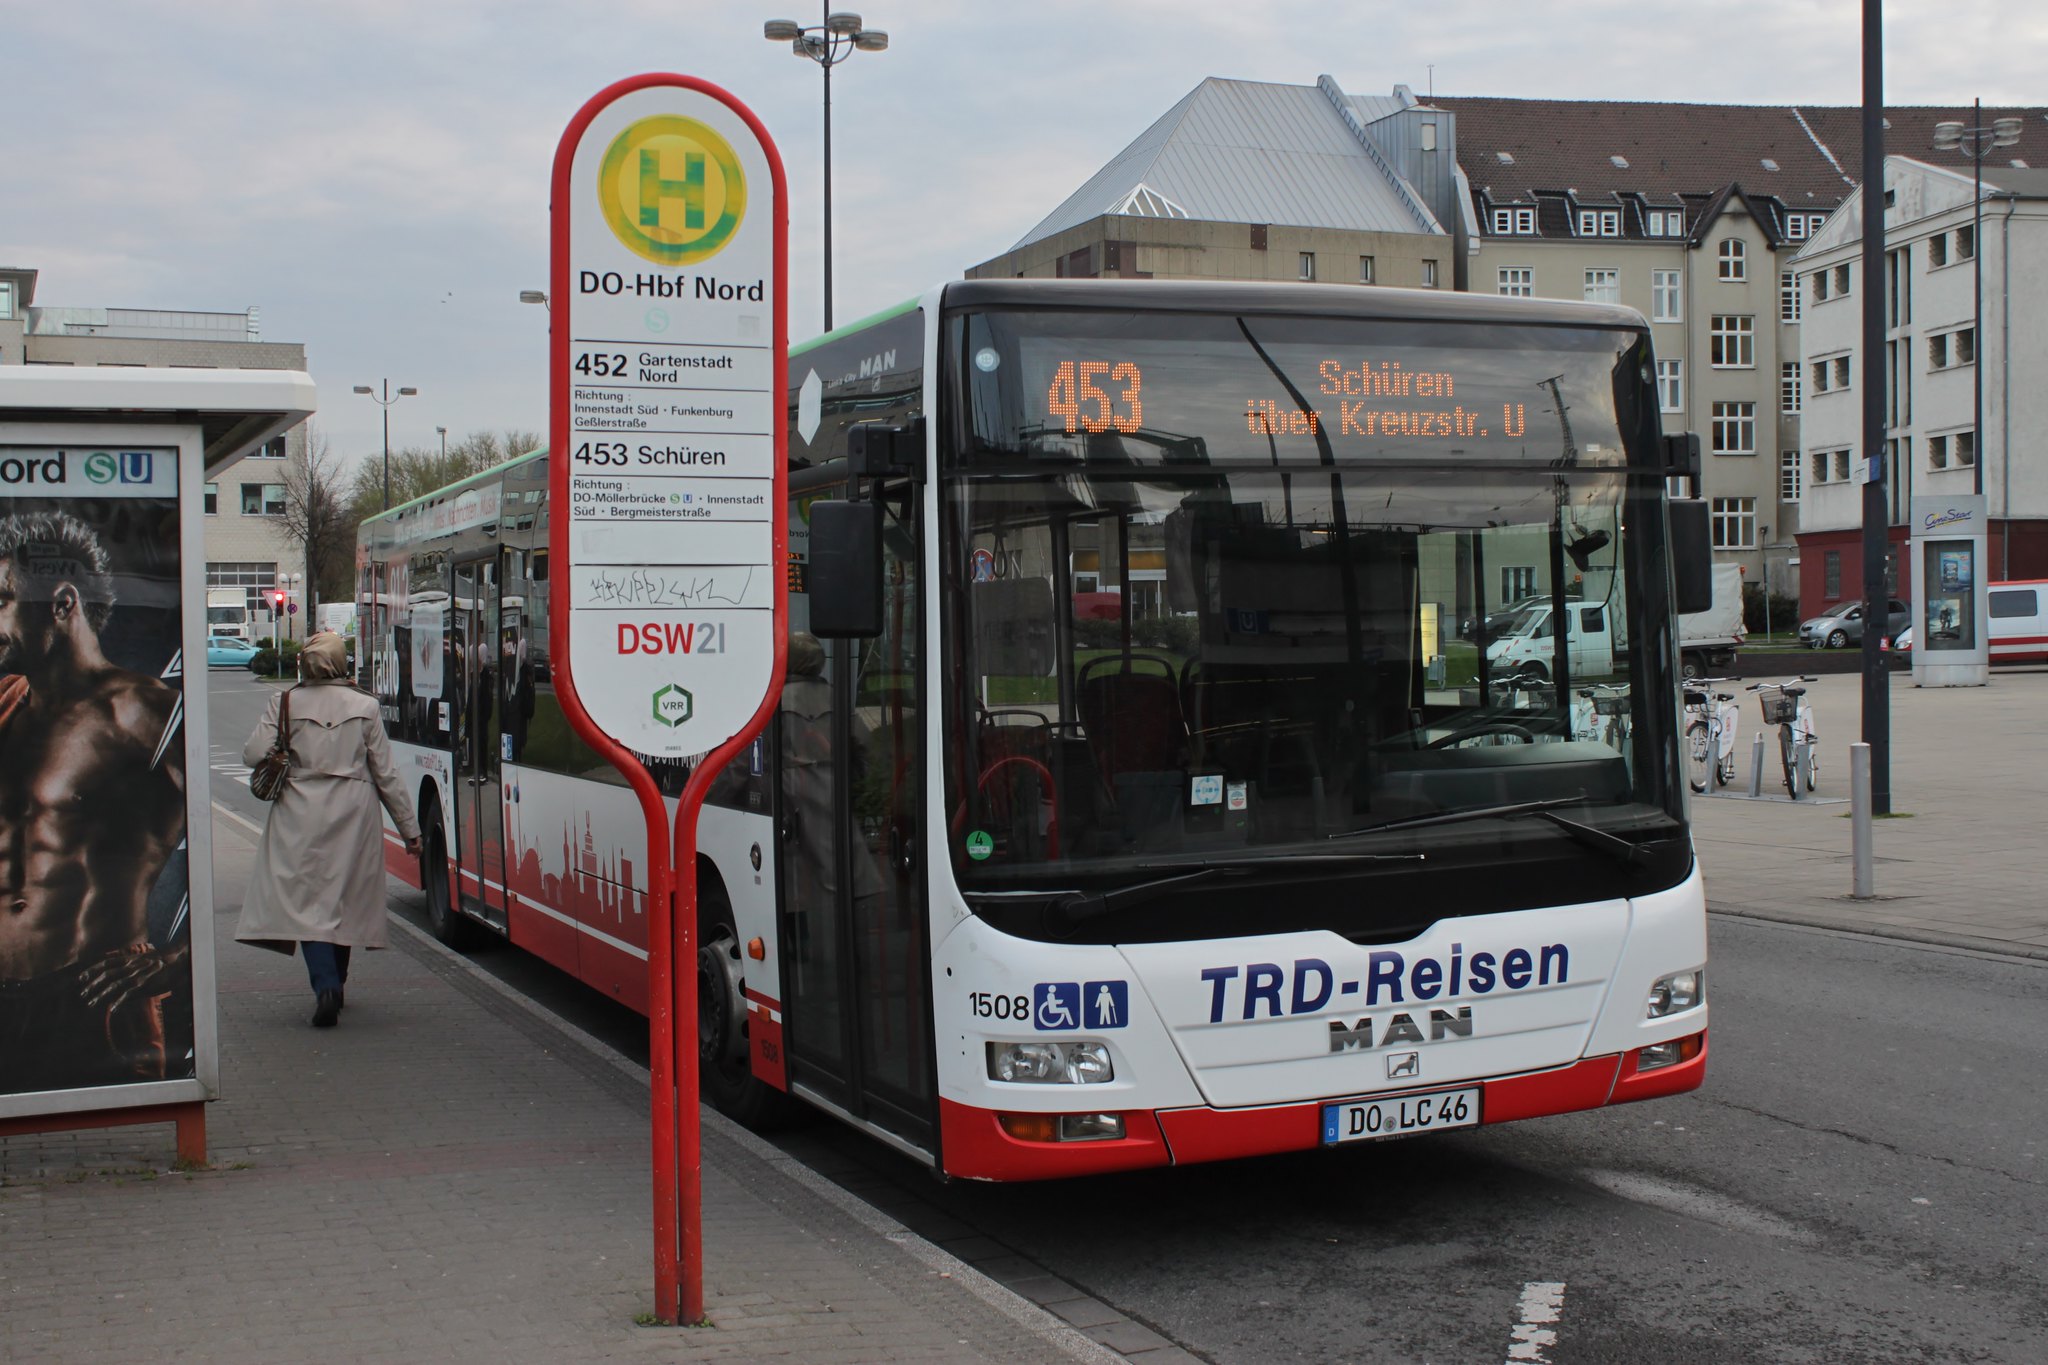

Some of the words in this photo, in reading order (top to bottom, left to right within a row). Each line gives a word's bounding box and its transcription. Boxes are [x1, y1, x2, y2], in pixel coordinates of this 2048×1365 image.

[639, 148, 705, 230] H
[580, 271, 685, 298] DO-Hbf
[695, 276, 764, 302] Nord
[575, 353, 628, 378] 452
[639, 352, 733, 369] Gartenstadt
[639, 369, 678, 383] Nord
[860, 349, 897, 379] MAN
[1319, 359, 1454, 397] Schüren
[575, 390, 624, 403] Richtung
[575, 404, 633, 415] Innenstadt
[637, 404, 659, 415] Süd
[671, 405, 733, 419] Funkenburg
[1048, 361, 1143, 433] 453
[575, 417, 647, 428] Geßlerstraße
[1247, 399, 1323, 436] über
[1341, 400, 1489, 437] Kreuzstr.
[1503, 403, 1526, 437] U
[0, 451, 66, 484] ord
[575, 442, 628, 466] 453
[638, 445, 726, 465] Schüren
[573, 479, 623, 491] Richtung
[573, 492, 666, 504] DO-Möllerbrücke
[707, 494, 764, 505] Innenstadt
[574, 505, 595, 516] Süd
[610, 506, 711, 519] Bergmeisterstraße
[618, 623, 725, 655] DSW21
[662, 702, 684, 711] VRR
[975, 831, 984, 846] 4
[1200, 942, 1570, 1024] TRD-Reisen
[969, 991, 1030, 1021] 1508
[1328, 1005, 1473, 1053] MAN
[1349, 1104, 1382, 1135] DO
[1400, 1098, 1432, 1129] LC
[1438, 1094, 1468, 1123] 46
